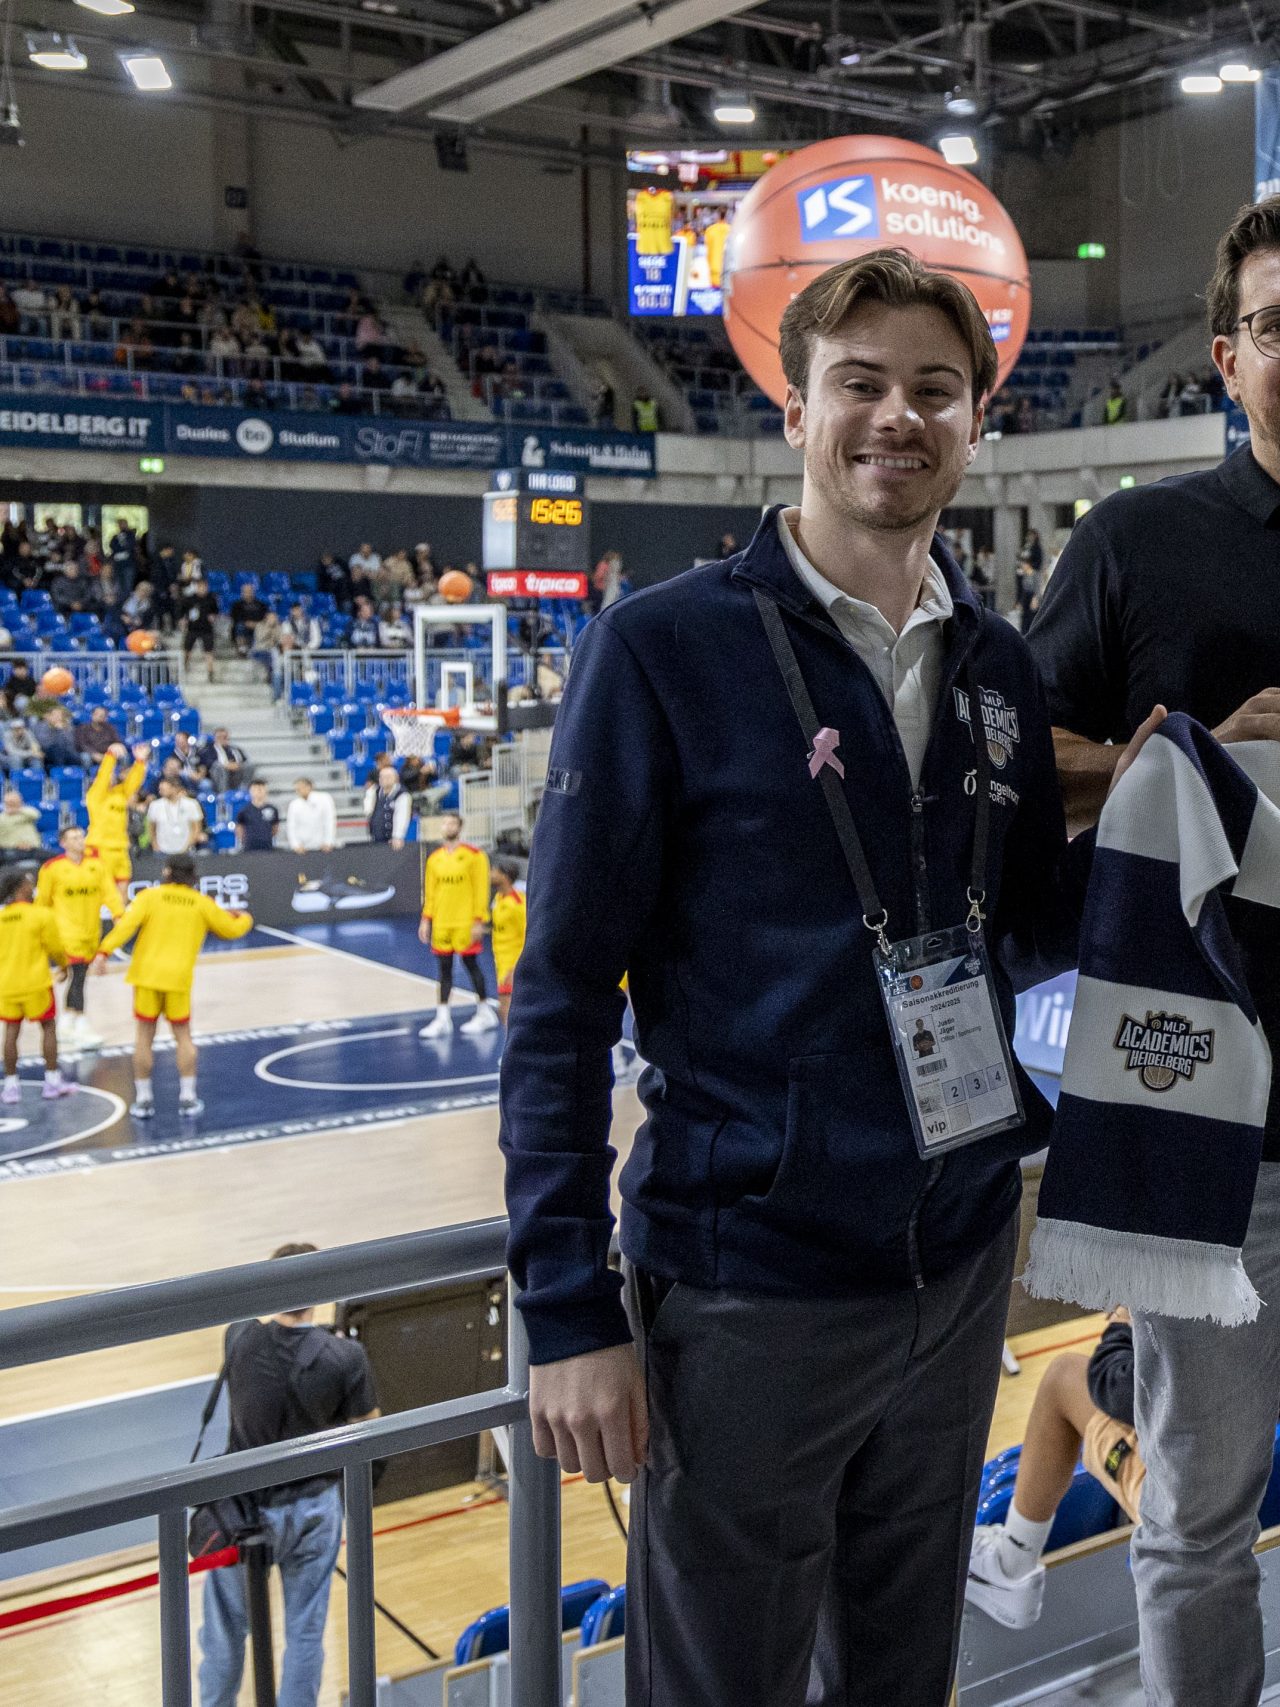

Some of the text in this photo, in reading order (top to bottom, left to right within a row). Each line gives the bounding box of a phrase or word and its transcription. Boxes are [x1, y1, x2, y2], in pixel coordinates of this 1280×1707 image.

[881, 177, 984, 224] koenig
[886, 209, 1006, 256] solutions
[279, 430, 341, 448] Studium
[983, 694, 1003, 707] MLP
[959, 692, 1019, 740] ADEMICS
[990, 780, 1020, 805] ngelhorn
[902, 980, 980, 1009] Saisonakkreditierung
[930, 996, 961, 1012] 2024/2025
[1118, 1020, 1211, 1060] ACADEMICS
[1163, 1020, 1187, 1034] MLP
[1129, 1050, 1193, 1076] HEIDELBERG
[951, 1070, 1002, 1098] 2 3 4
[927, 1120, 947, 1134] vip
